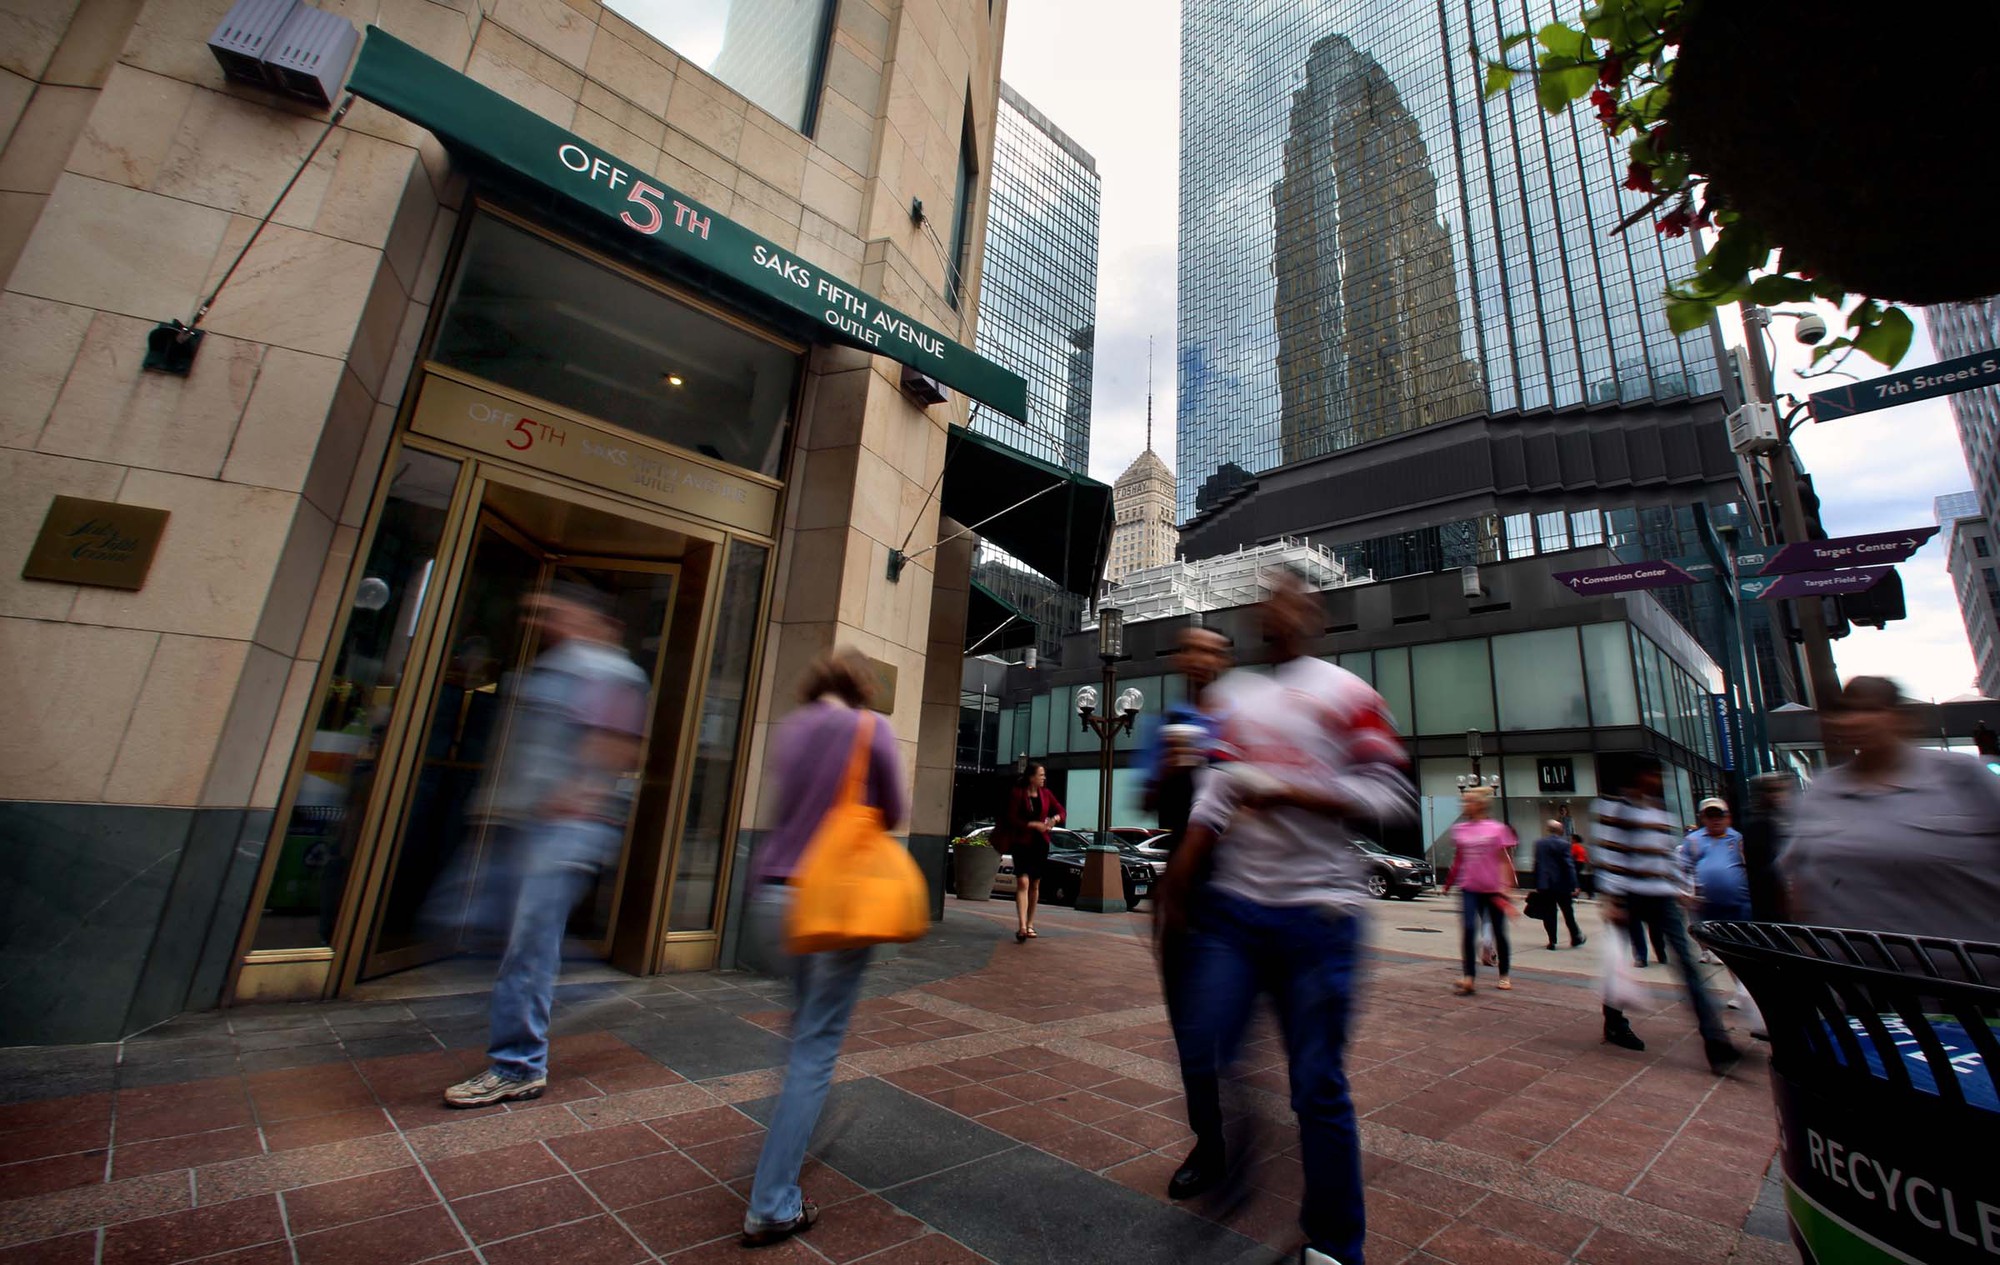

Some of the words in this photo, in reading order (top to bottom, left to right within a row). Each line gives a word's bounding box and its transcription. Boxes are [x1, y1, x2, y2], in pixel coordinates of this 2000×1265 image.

[559, 144, 629, 190] OFF
[620, 180, 711, 241] 5TH
[752, 245, 811, 289] SAKS
[817, 278, 868, 319] FIFTH
[872, 310, 945, 360] AVENUE
[825, 310, 882, 347] OUTLET
[1875, 381, 1909, 398] 7th
[1912, 366, 1979, 389] Street
[468, 402, 513, 427] OFF
[1117, 481, 1147, 499] FOSHAY
[1814, 547, 1851, 558] Target
[1856, 542, 1898, 553] Center
[1582, 574, 1633, 585] Convention
[1634, 569, 1667, 579] Center
[1804, 578, 1833, 588] Target
[1834, 575, 1856, 585] Field
[1543, 766, 1567, 784] GAP
